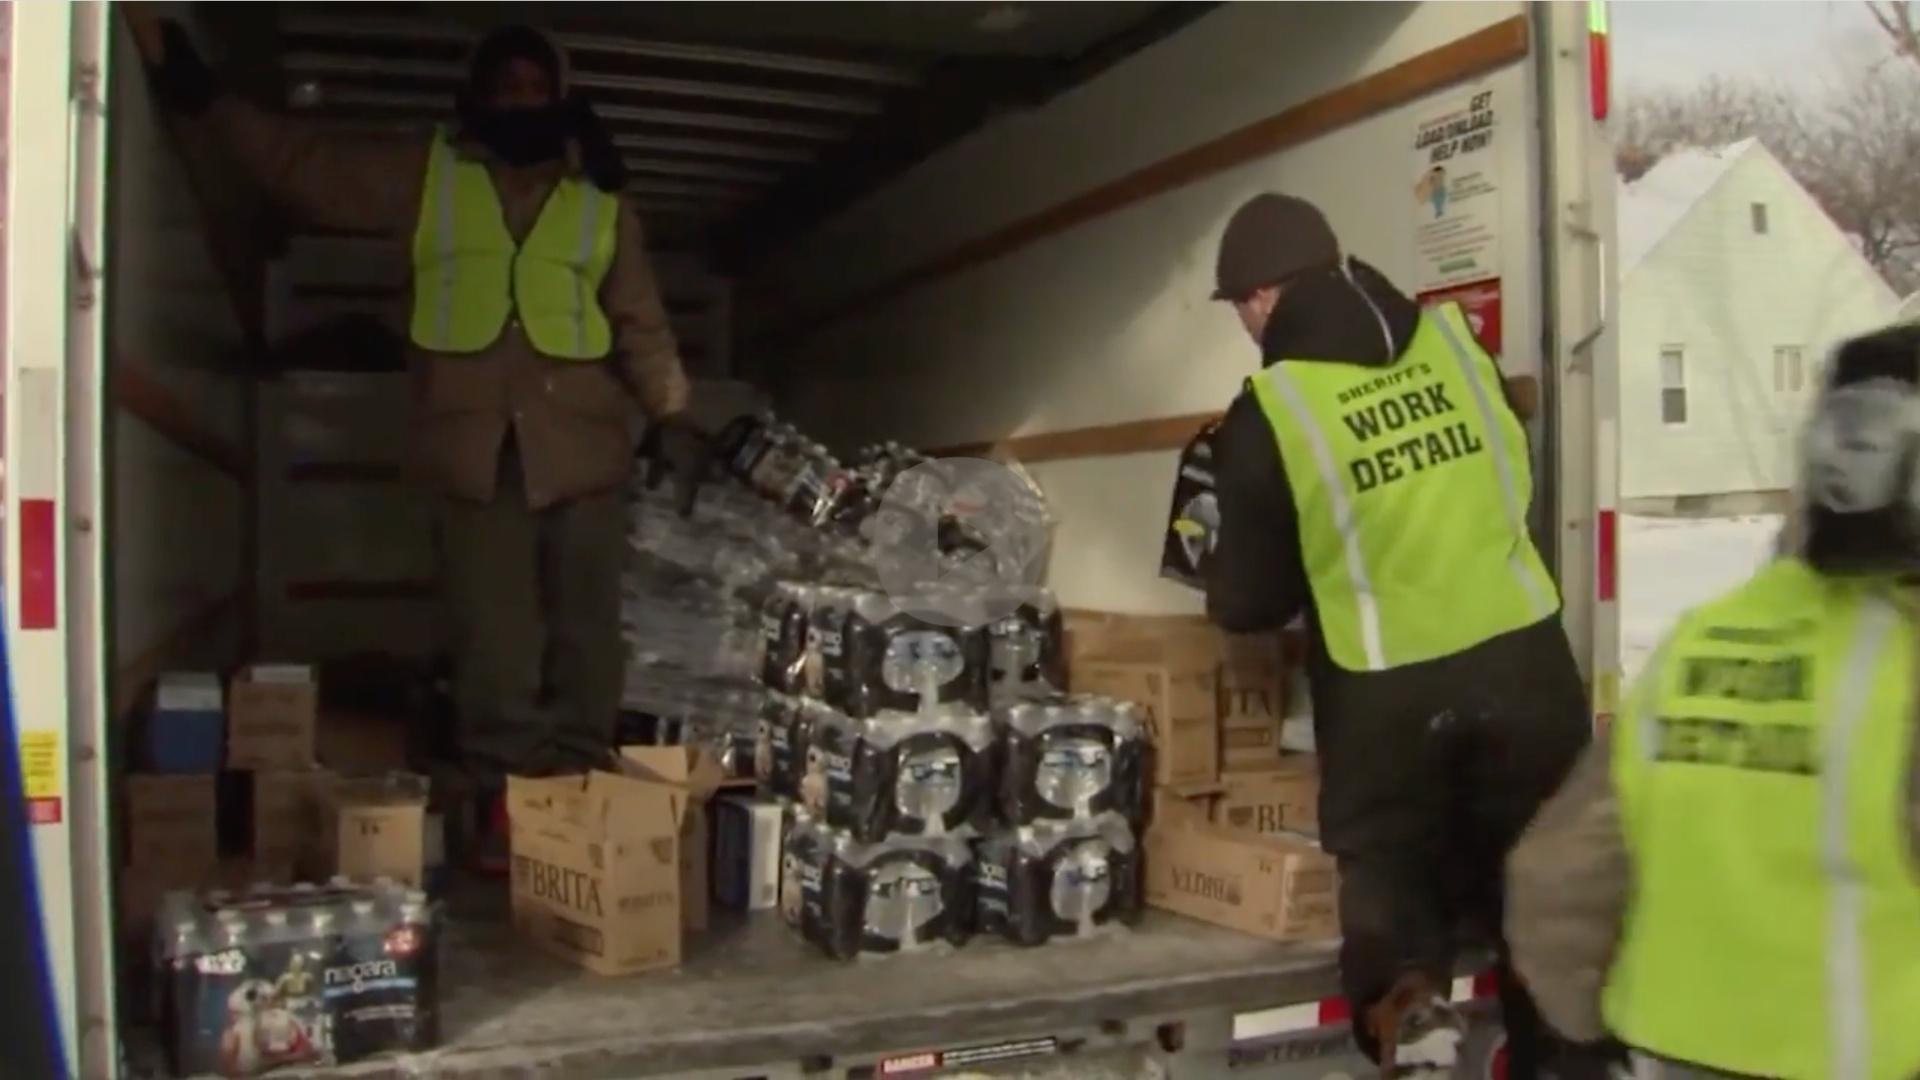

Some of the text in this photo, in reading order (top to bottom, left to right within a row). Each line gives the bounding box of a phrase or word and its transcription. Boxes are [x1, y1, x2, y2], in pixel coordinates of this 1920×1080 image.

[1469, 91, 1493, 112] GET
[1430, 139, 1459, 164] HELP
[1337, 362, 1432, 405] SHERIFF'S
[1343, 382, 1454, 443] WORK
[1349, 422, 1483, 493] DETAIL
[531, 859, 604, 918] BRITA
